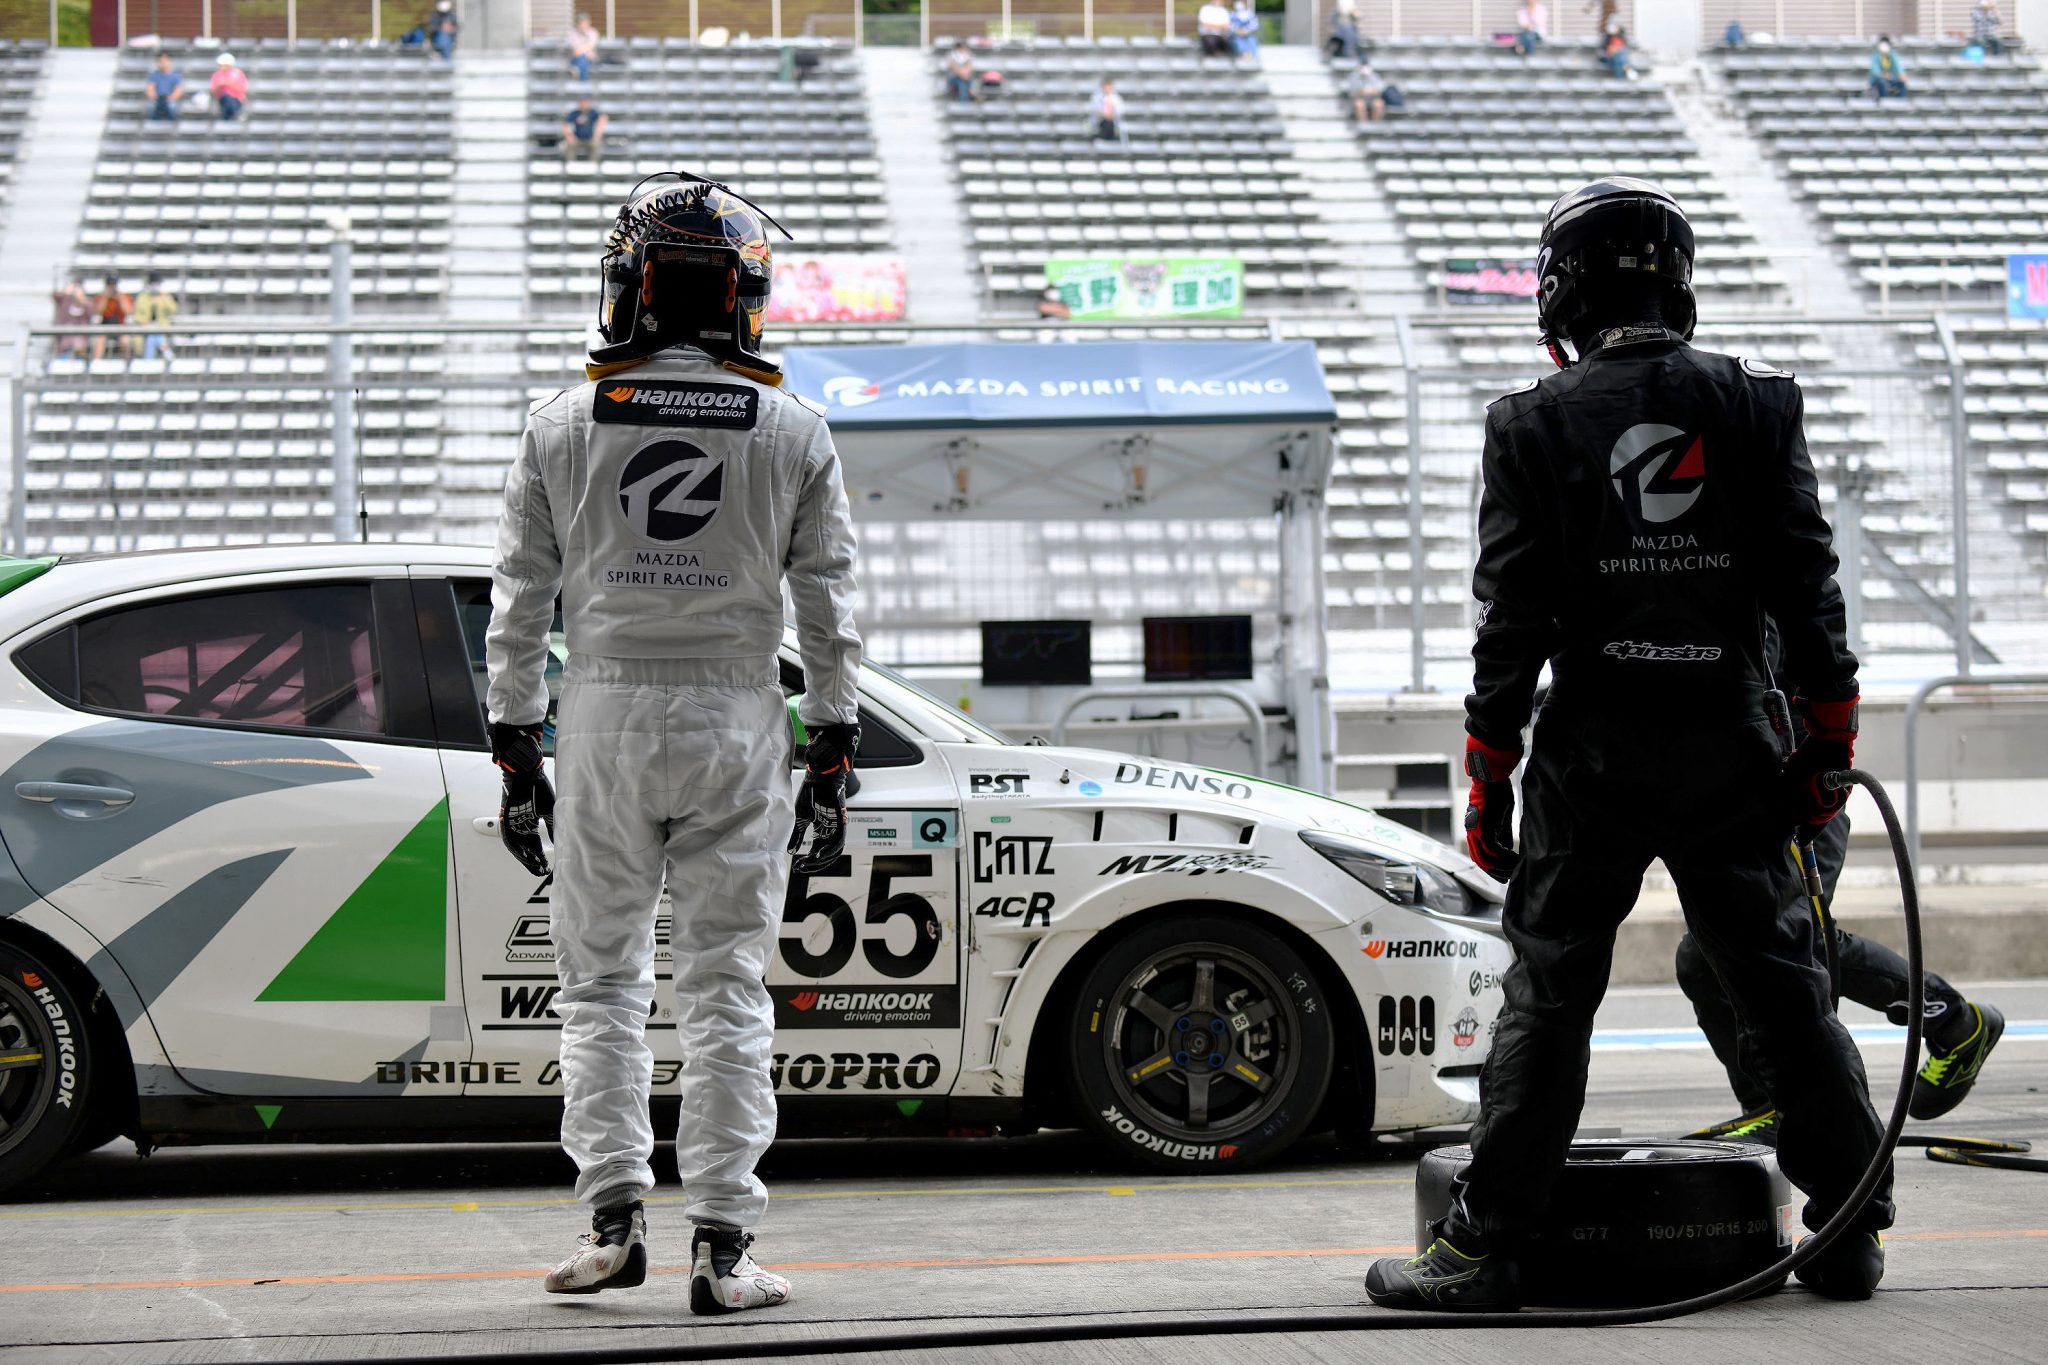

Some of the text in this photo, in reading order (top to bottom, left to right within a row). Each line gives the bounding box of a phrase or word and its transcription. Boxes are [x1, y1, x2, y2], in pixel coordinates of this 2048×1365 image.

[897, 376, 1291, 398] MAZDA SPIRIT RACING
[658, 407, 746, 418] driving emotion
[1632, 534, 1698, 550] MAZDA
[635, 552, 700, 567] MAZDA
[1599, 553, 1730, 573] SPIRIT RACING
[607, 571, 728, 587] SPIRIT RACING
[1114, 763, 1252, 799] DENSO
[920, 818, 947, 842] Q
[778, 853, 941, 978] 55
[975, 892, 1055, 928] 4CR
[844, 1011, 931, 1023] driving emotion
[1380, 1027, 1433, 1042] HAL
[375, 1061, 521, 1084] BRIDE
